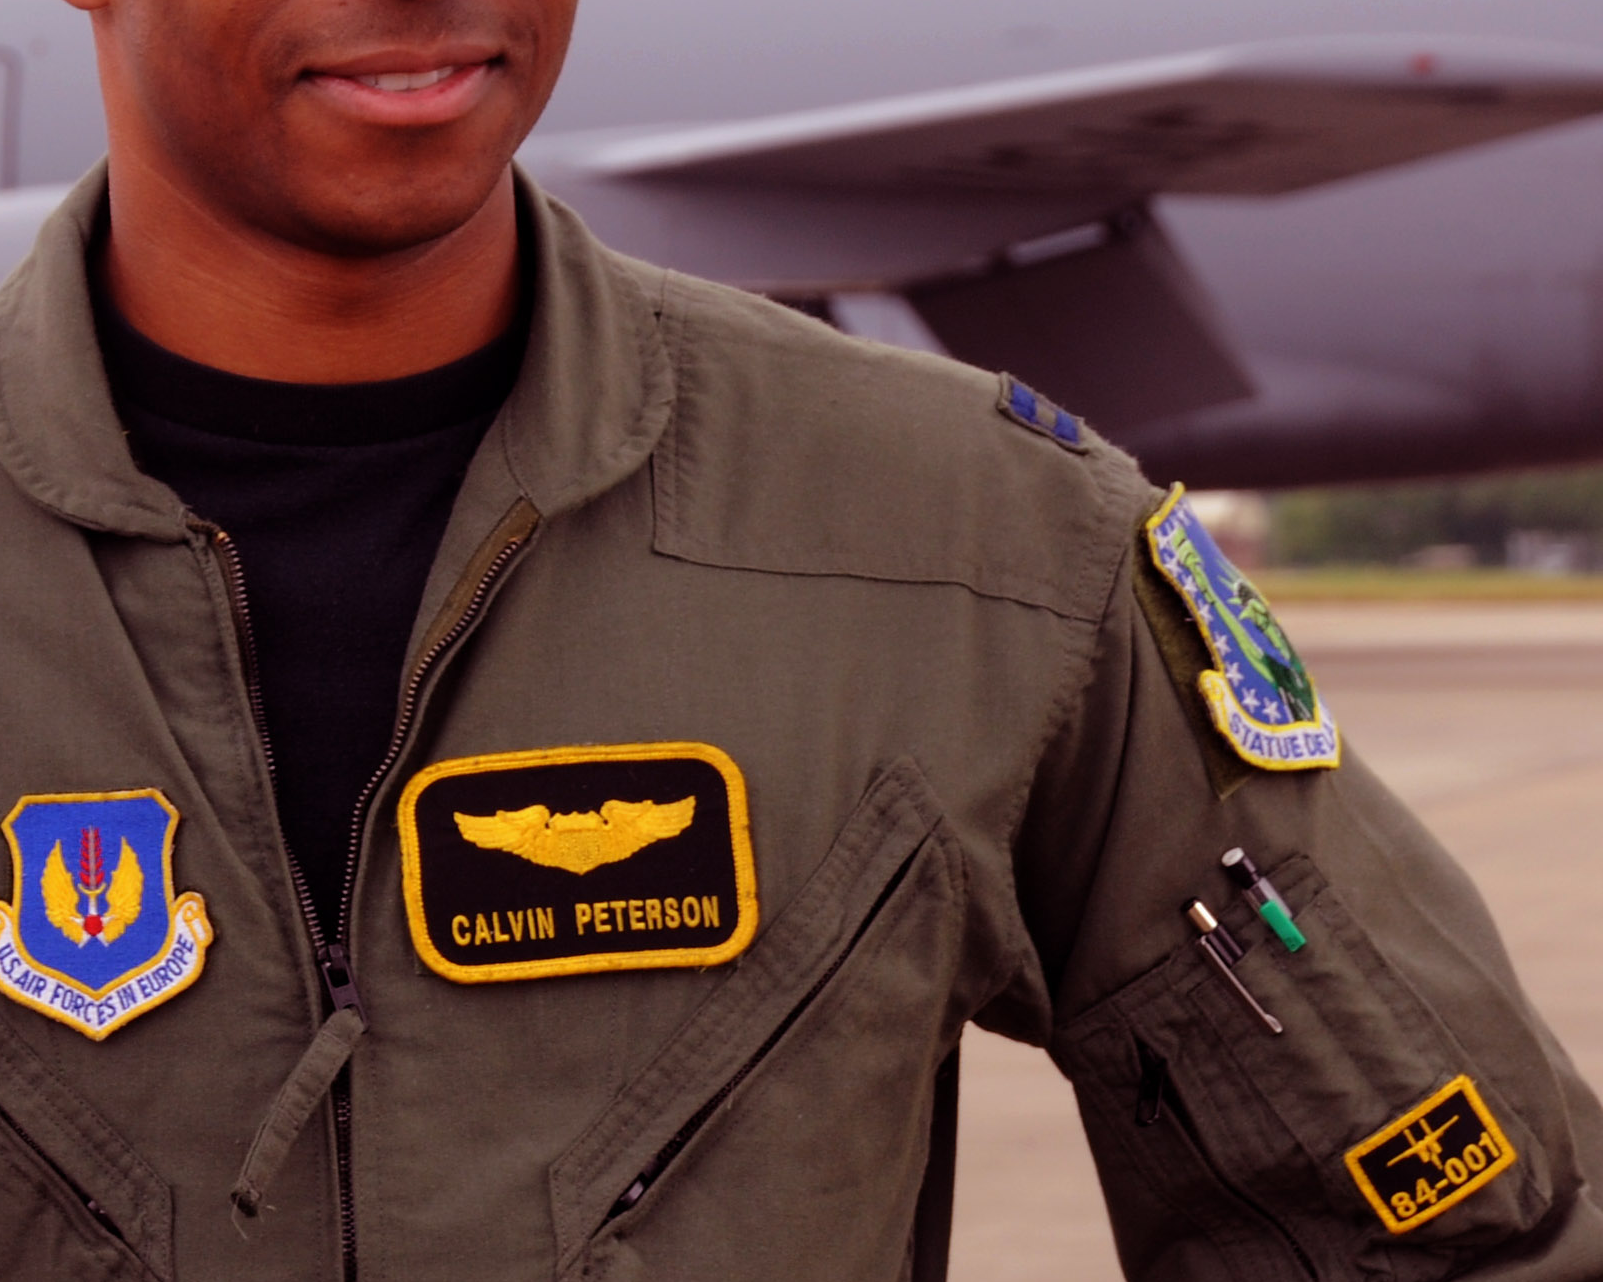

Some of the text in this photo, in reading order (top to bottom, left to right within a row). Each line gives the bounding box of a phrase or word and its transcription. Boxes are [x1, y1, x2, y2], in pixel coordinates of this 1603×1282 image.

[1229, 712, 1303, 759] STATUE
[451, 895, 720, 946] CALVIN PETERSON
[14, 967, 45, 999] AIR
[49, 984, 118, 1027] FORCES
[117, 984, 139, 1011] IN
[140, 933, 195, 999] EUROPE
[1390, 1131, 1502, 1218] 84-001
